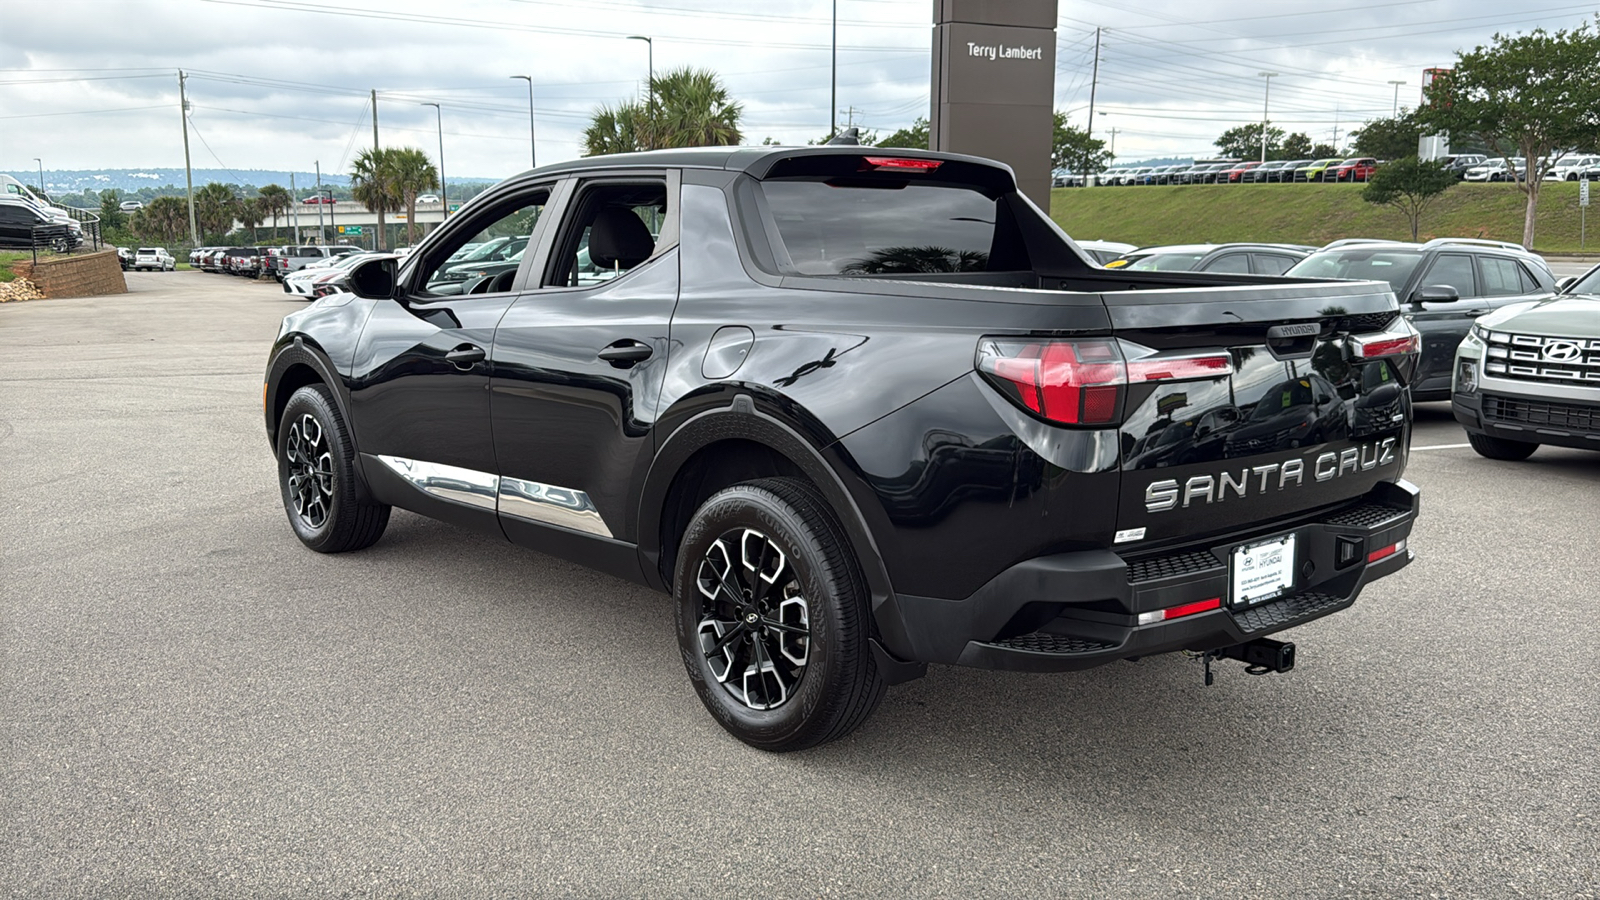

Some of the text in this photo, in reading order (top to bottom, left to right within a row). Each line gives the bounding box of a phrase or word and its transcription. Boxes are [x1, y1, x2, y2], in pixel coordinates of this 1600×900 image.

[967, 42, 1042, 60] Terry Lambert
[1280, 325, 1316, 336] HYUNDAI
[1145, 437, 1397, 513] SANTA CRUZ
[756, 508, 801, 560] KUMHO
[1259, 555, 1282, 568] HYUNDAI
